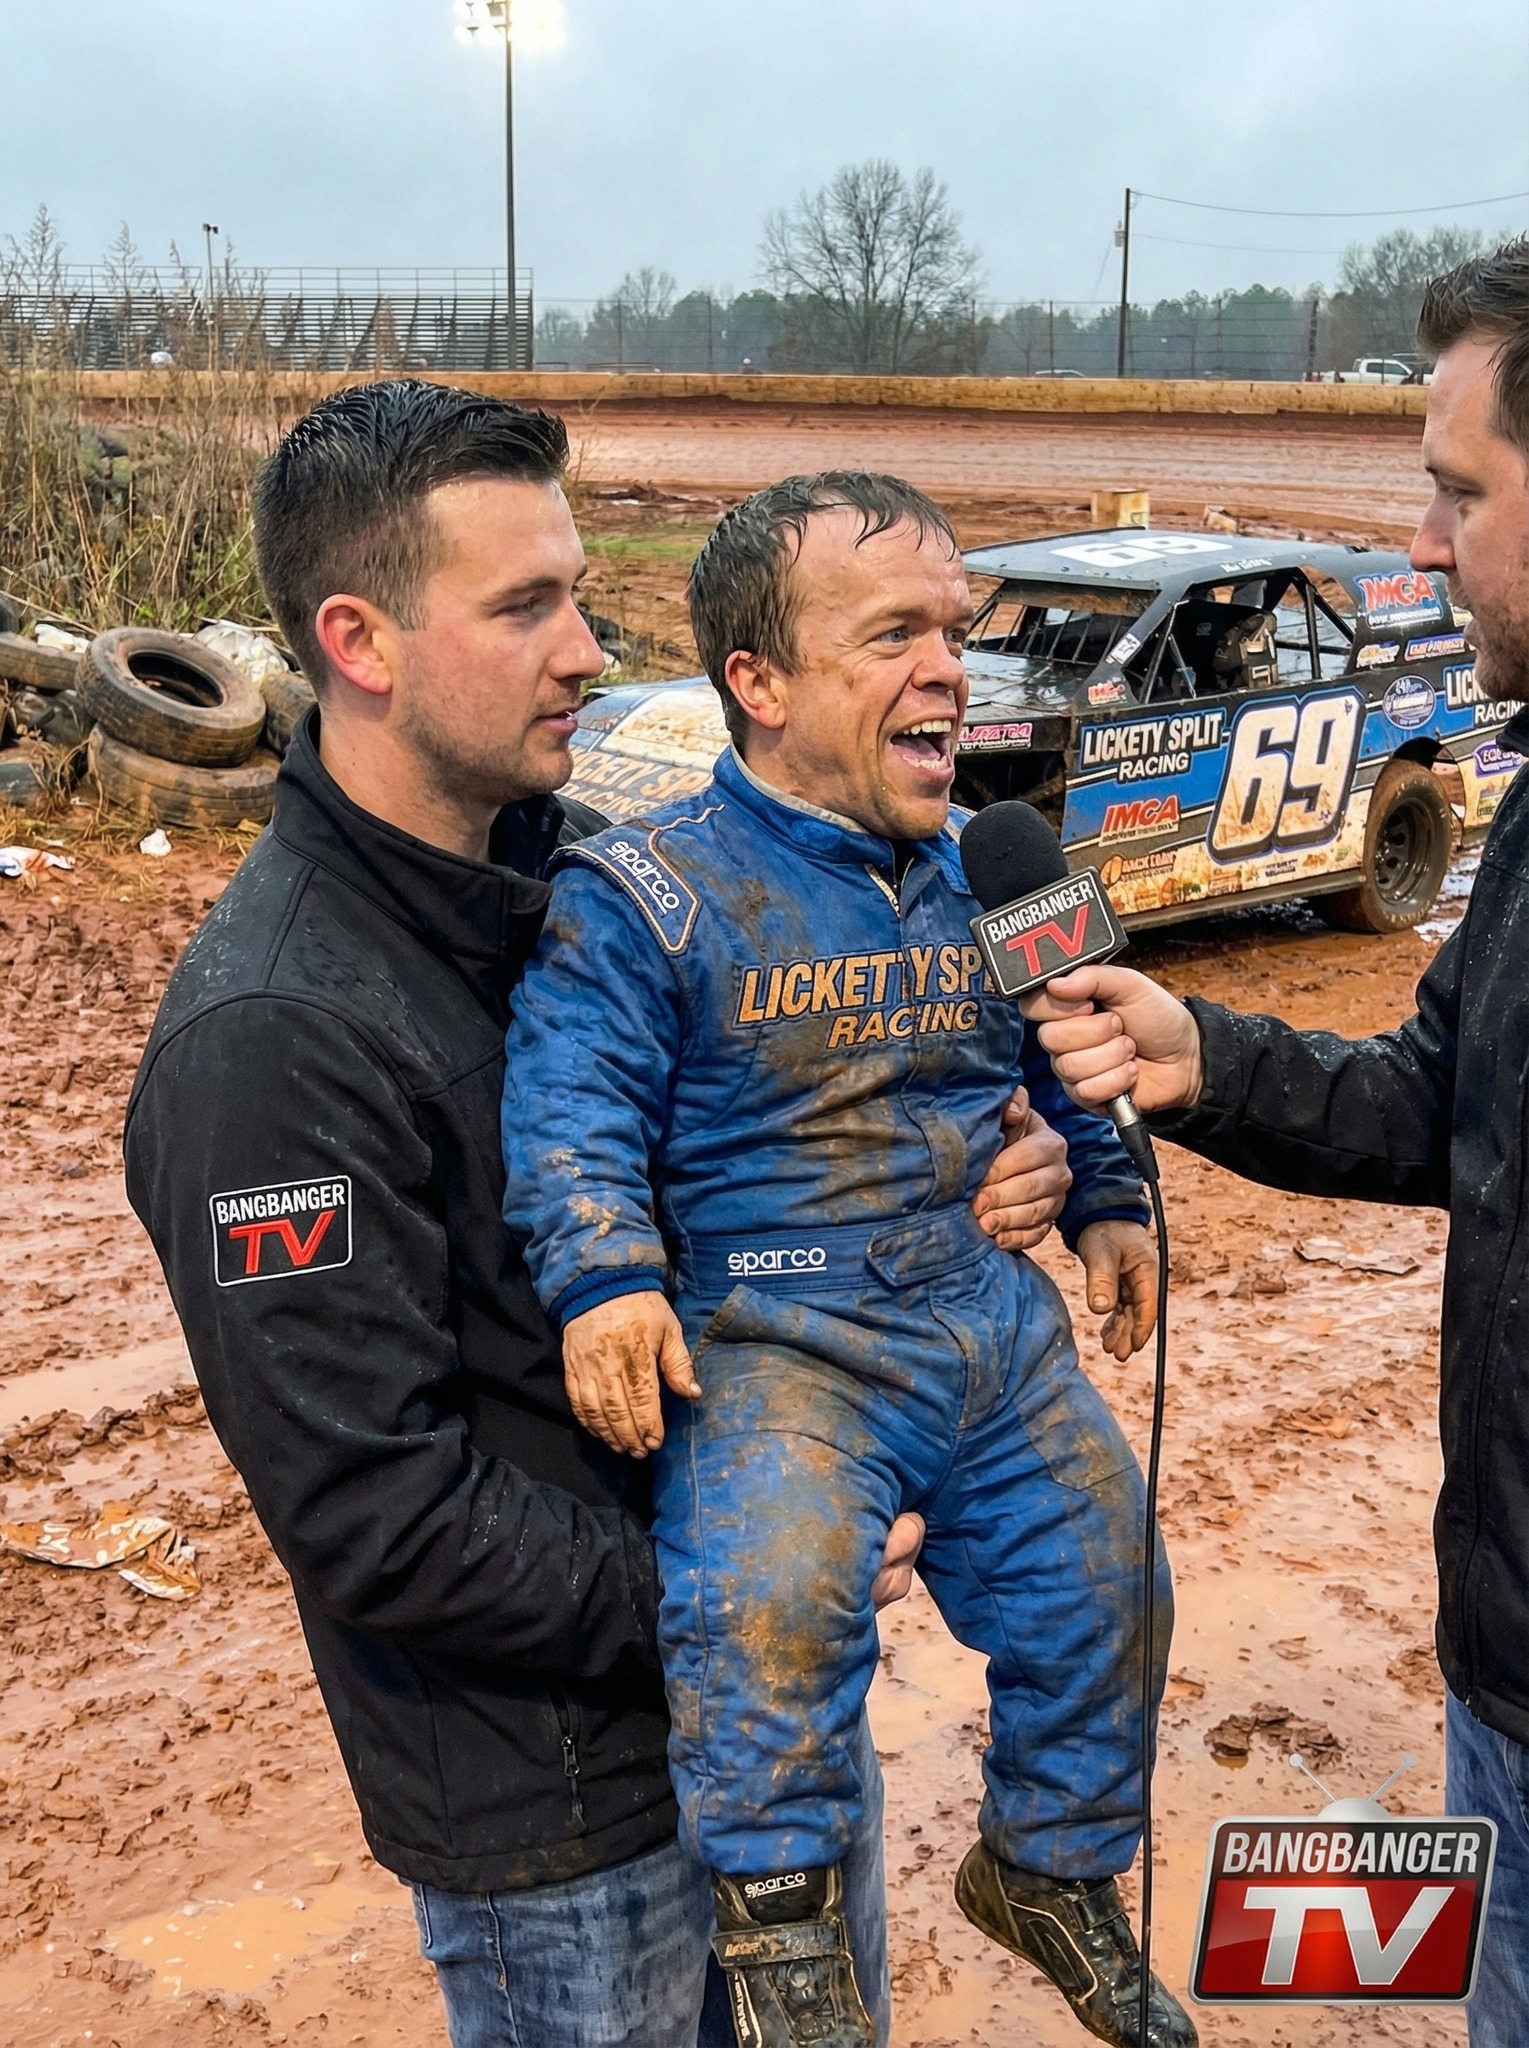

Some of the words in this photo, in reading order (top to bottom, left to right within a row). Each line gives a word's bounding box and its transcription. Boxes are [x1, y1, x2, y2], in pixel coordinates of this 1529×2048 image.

[1475, 700, 1526, 724] RACIN
[1083, 721, 1166, 765] LICKETY
[1168, 713, 1222, 750] SPLIT
[1118, 752, 1189, 781] RACING
[1212, 694, 1361, 852] 69
[1099, 795, 1179, 834] IMCA
[605, 841, 680, 915] sparco
[987, 879, 1096, 944] BANGBANGER
[1006, 903, 1090, 977] TV
[827, 1001, 978, 1049] RACING
[216, 1184, 345, 1224] BANGBANGER
[229, 1210, 336, 1274] TV
[728, 1247, 827, 1276] sparco
[745, 1872, 807, 1900] sparco
